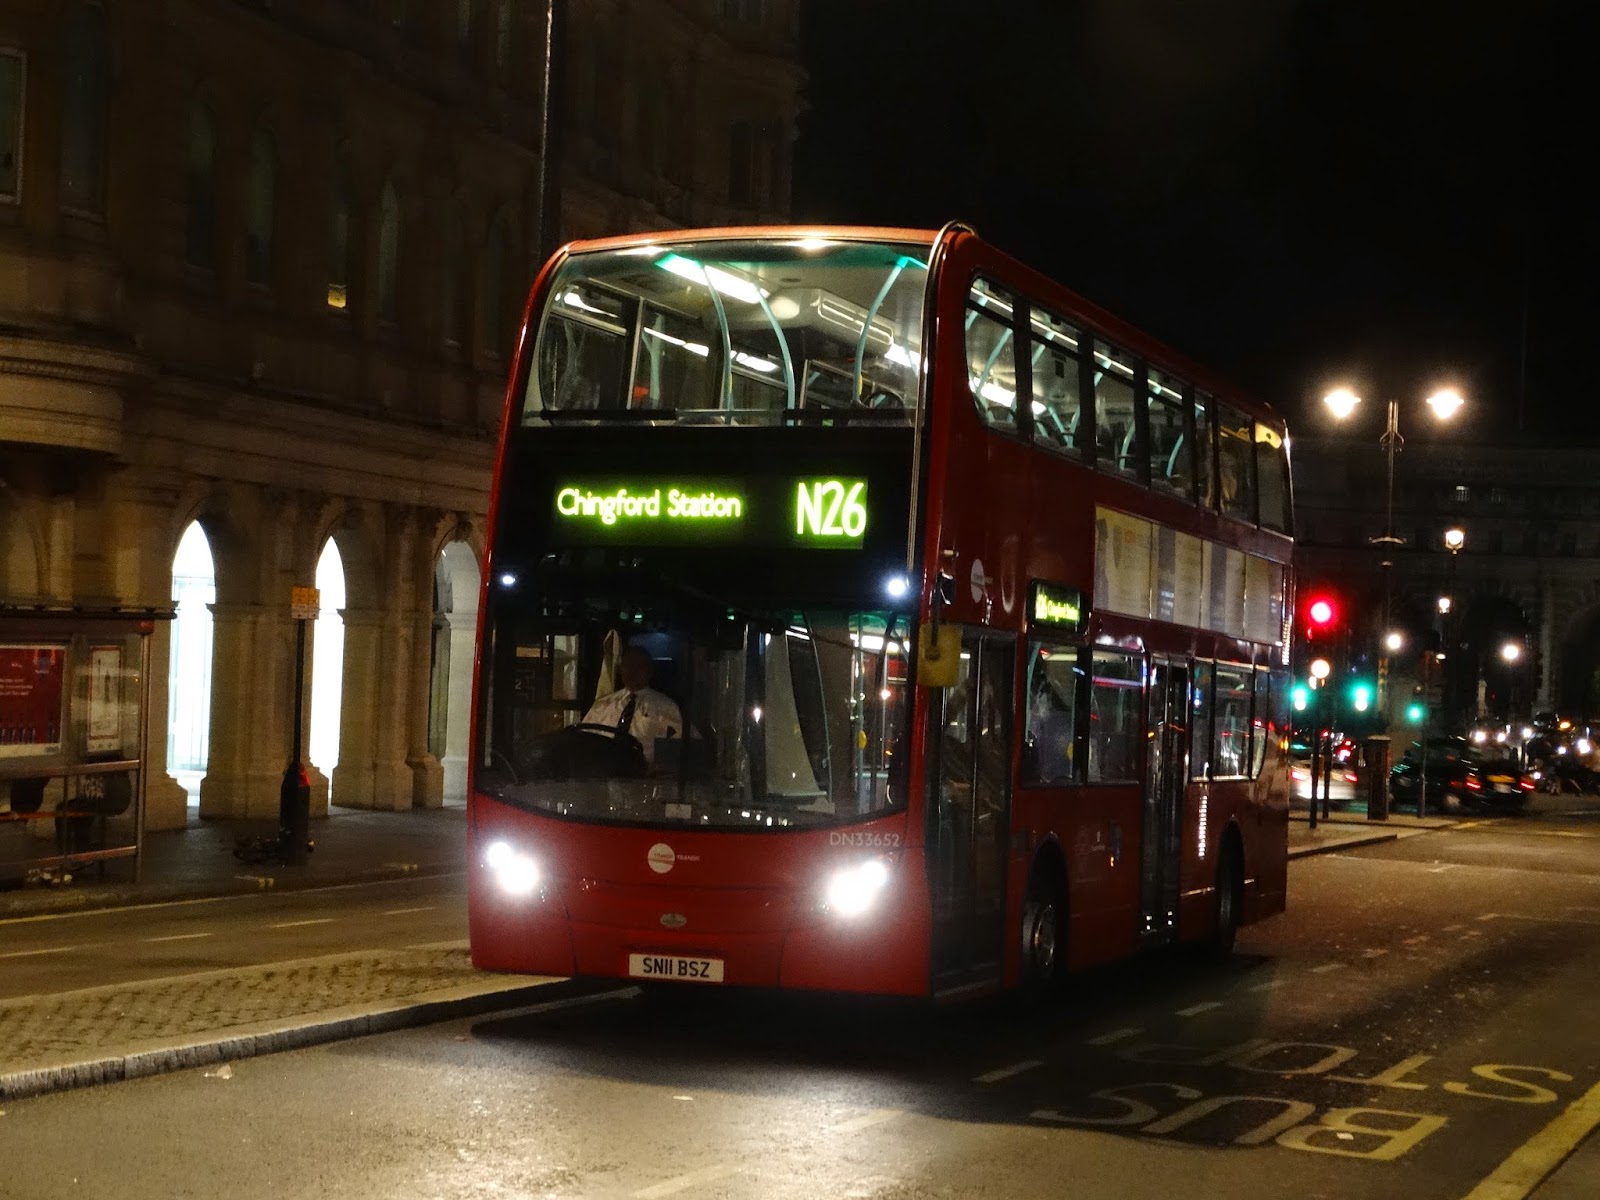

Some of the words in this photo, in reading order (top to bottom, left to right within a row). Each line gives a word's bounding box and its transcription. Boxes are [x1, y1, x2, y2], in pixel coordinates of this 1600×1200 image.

[557, 488, 660, 526] Chingford
[666, 488, 741, 518] Station
[796, 480, 867, 537] N26
[676, 853, 701, 861] TRANT
[829, 831, 900, 847] DN33652
[677, 960, 711, 978] BSZ
[1113, 1039, 1575, 1104] STOP
[1029, 1082, 1449, 1161] BUS
